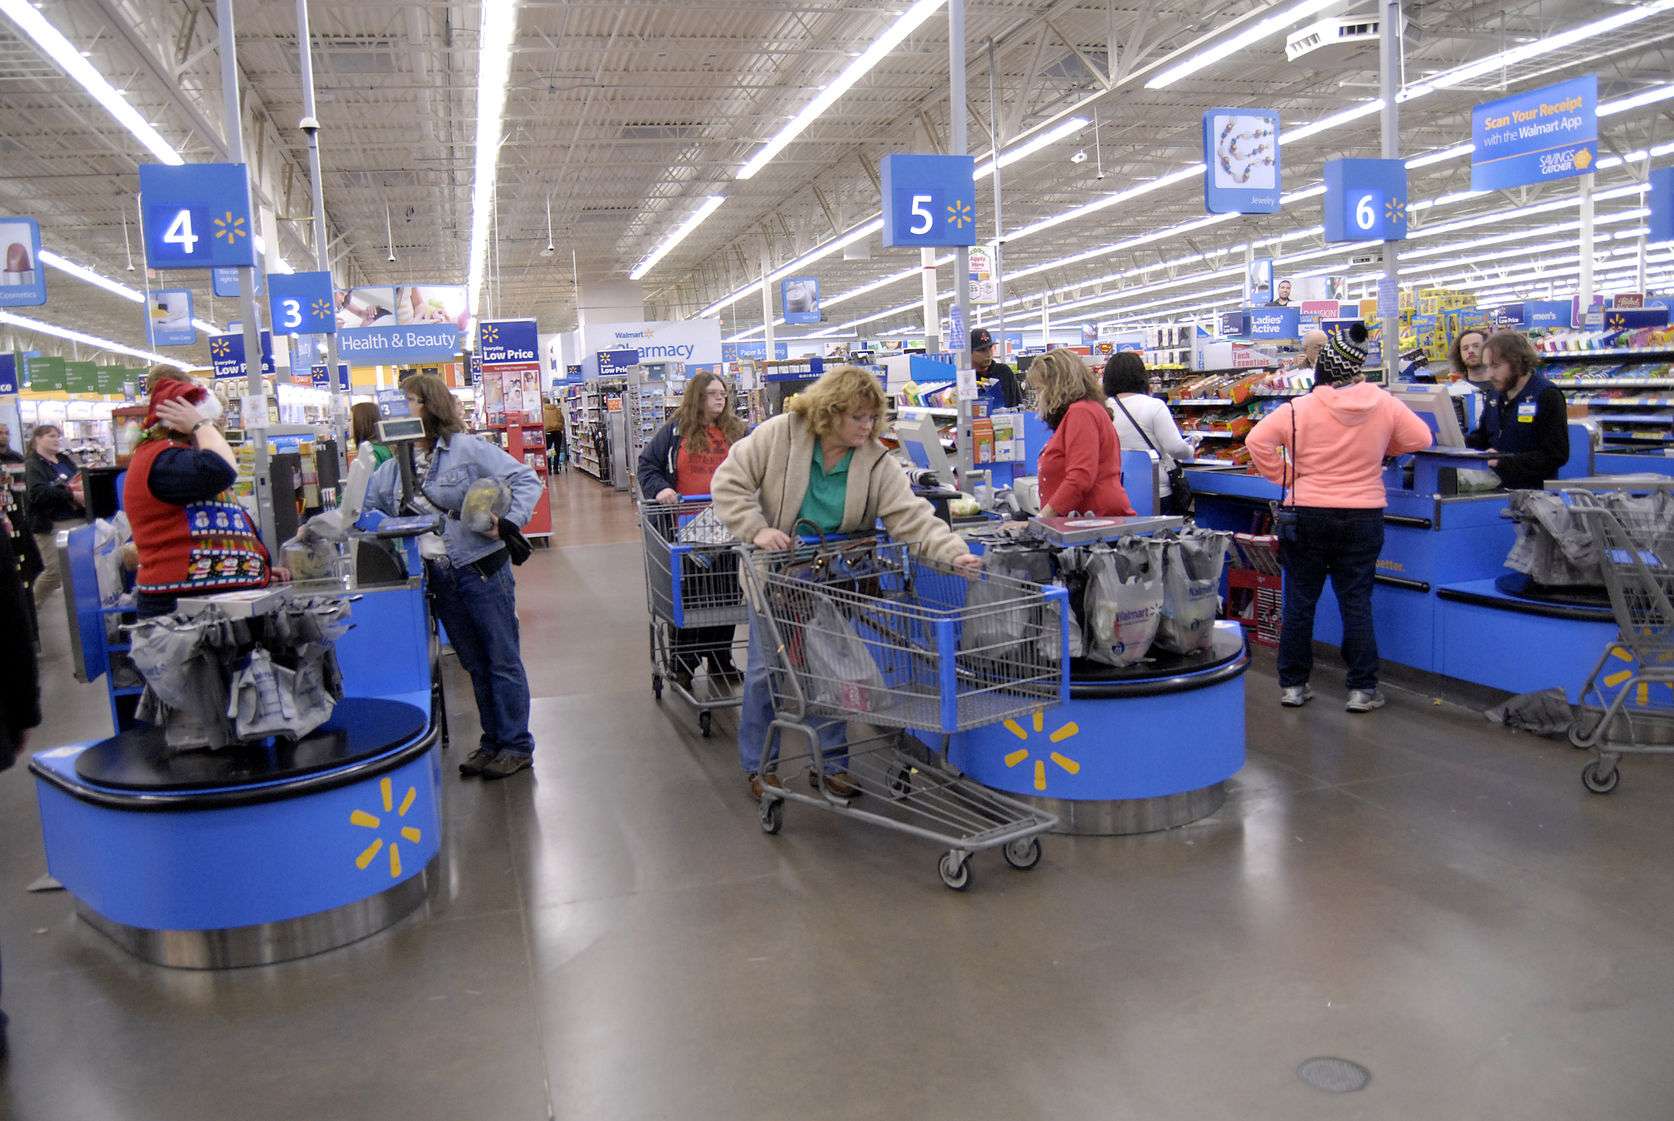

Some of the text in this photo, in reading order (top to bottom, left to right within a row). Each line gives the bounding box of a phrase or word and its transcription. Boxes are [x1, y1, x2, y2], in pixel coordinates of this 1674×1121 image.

[1485, 96, 1582, 131] Scan Your Receipt
[1483, 116, 1582, 147] with the Walmart App
[1539, 149, 1575, 168] SAVINGS
[910, 195, 934, 235] 5
[1355, 194, 1375, 230] 6
[164, 209, 198, 253] 4
[281, 299, 302, 328] 3
[615, 331, 644, 339] Walmart
[1251, 325, 1280, 333] Active
[341, 332, 456, 351] Health & Beauty
[483, 349, 534, 360] Low Price
[216, 365, 238, 376] Low
